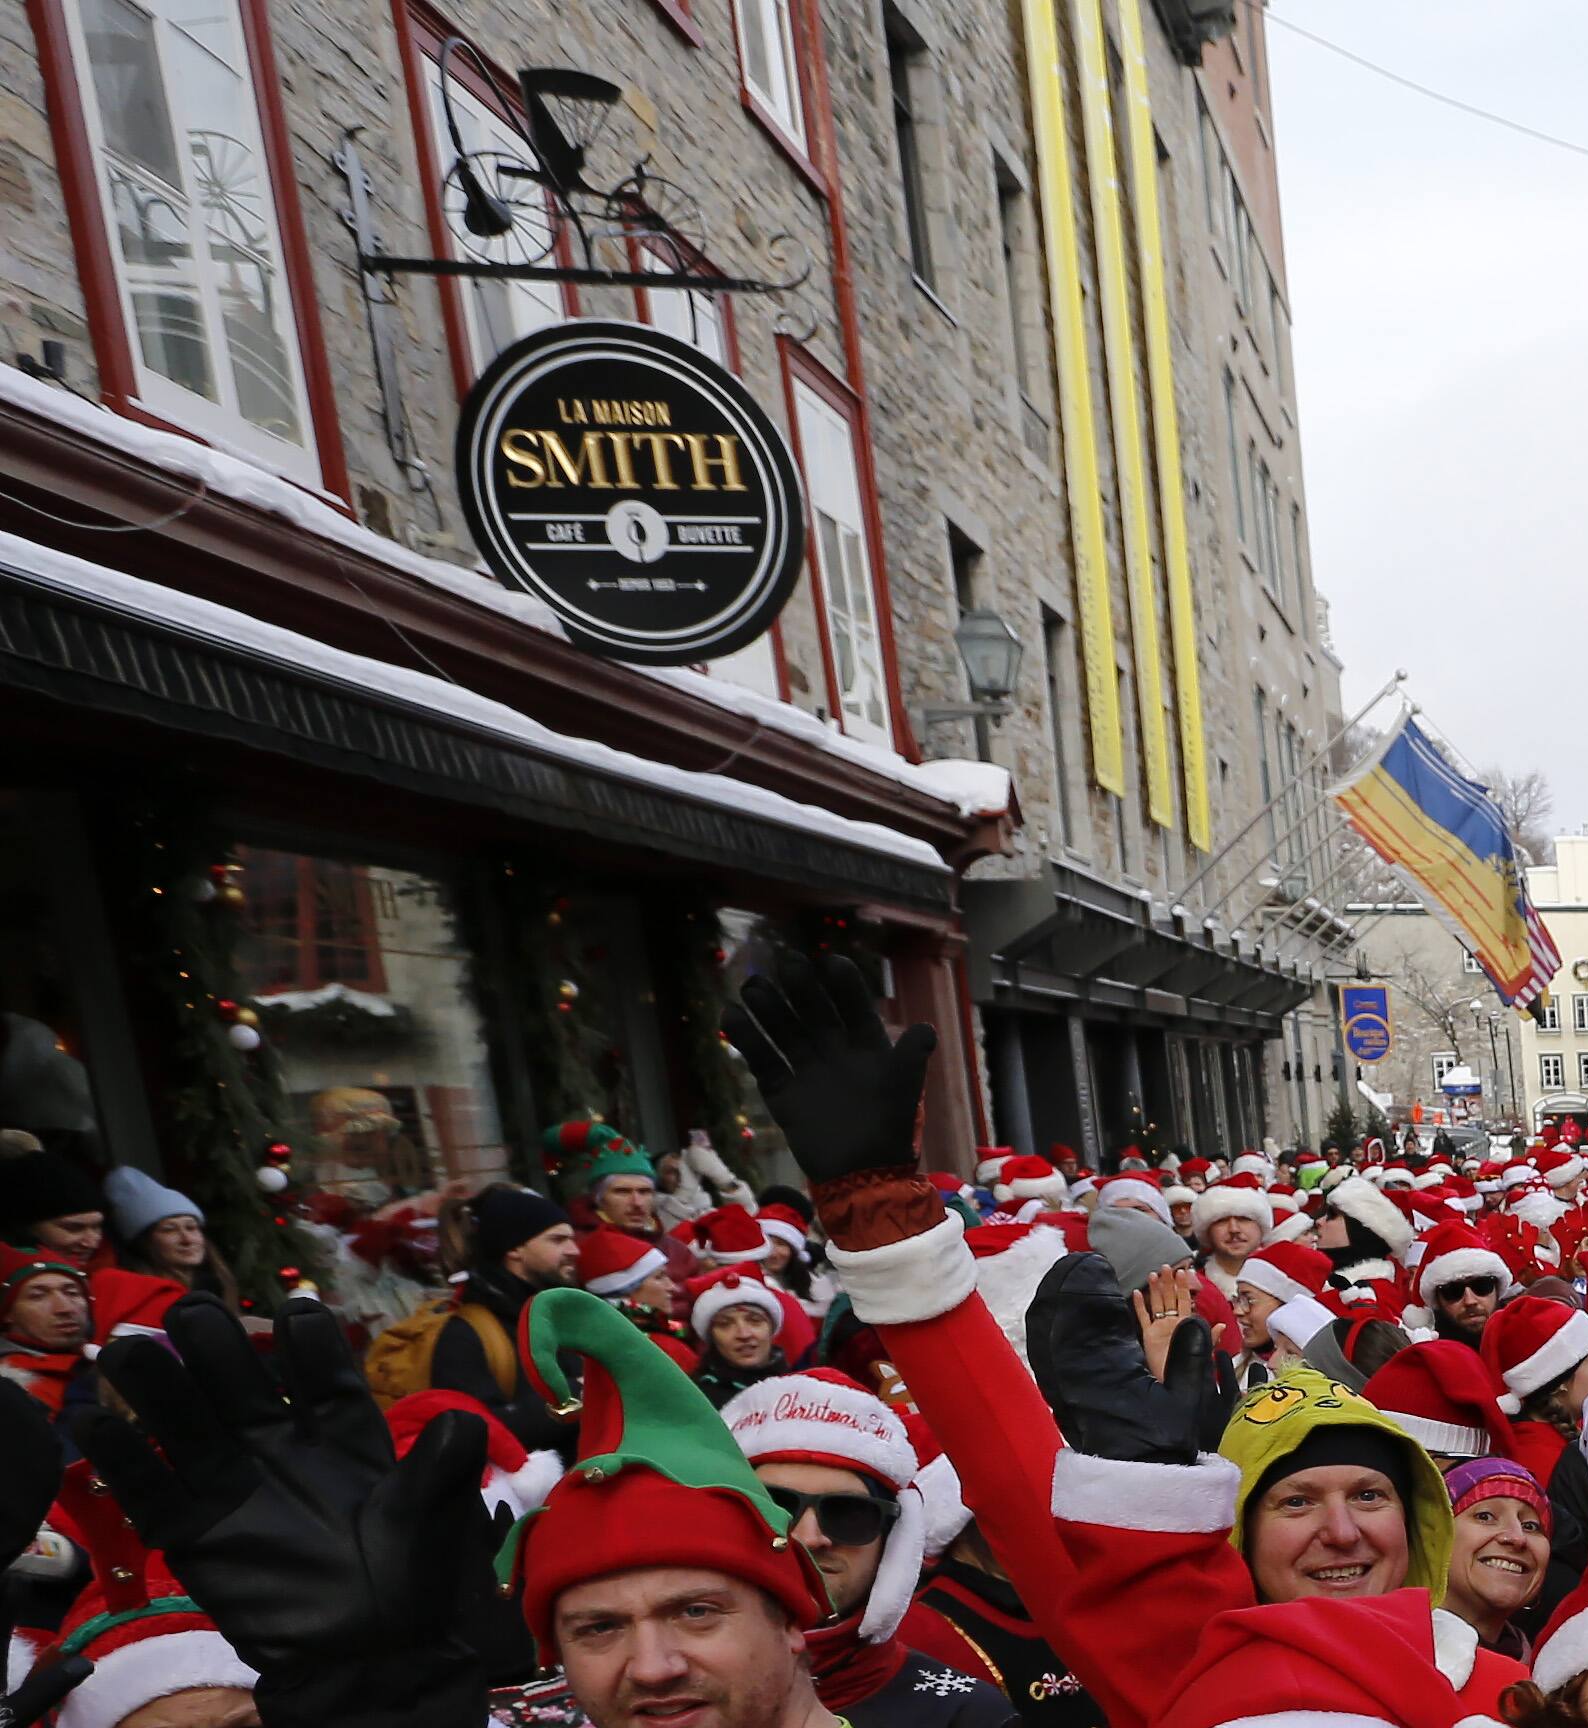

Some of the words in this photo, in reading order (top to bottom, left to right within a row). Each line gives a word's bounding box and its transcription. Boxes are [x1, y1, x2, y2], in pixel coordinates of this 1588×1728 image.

[557, 398, 589, 424] LA
[592, 399, 672, 427] MAISON
[500, 428, 749, 491] SMITH
